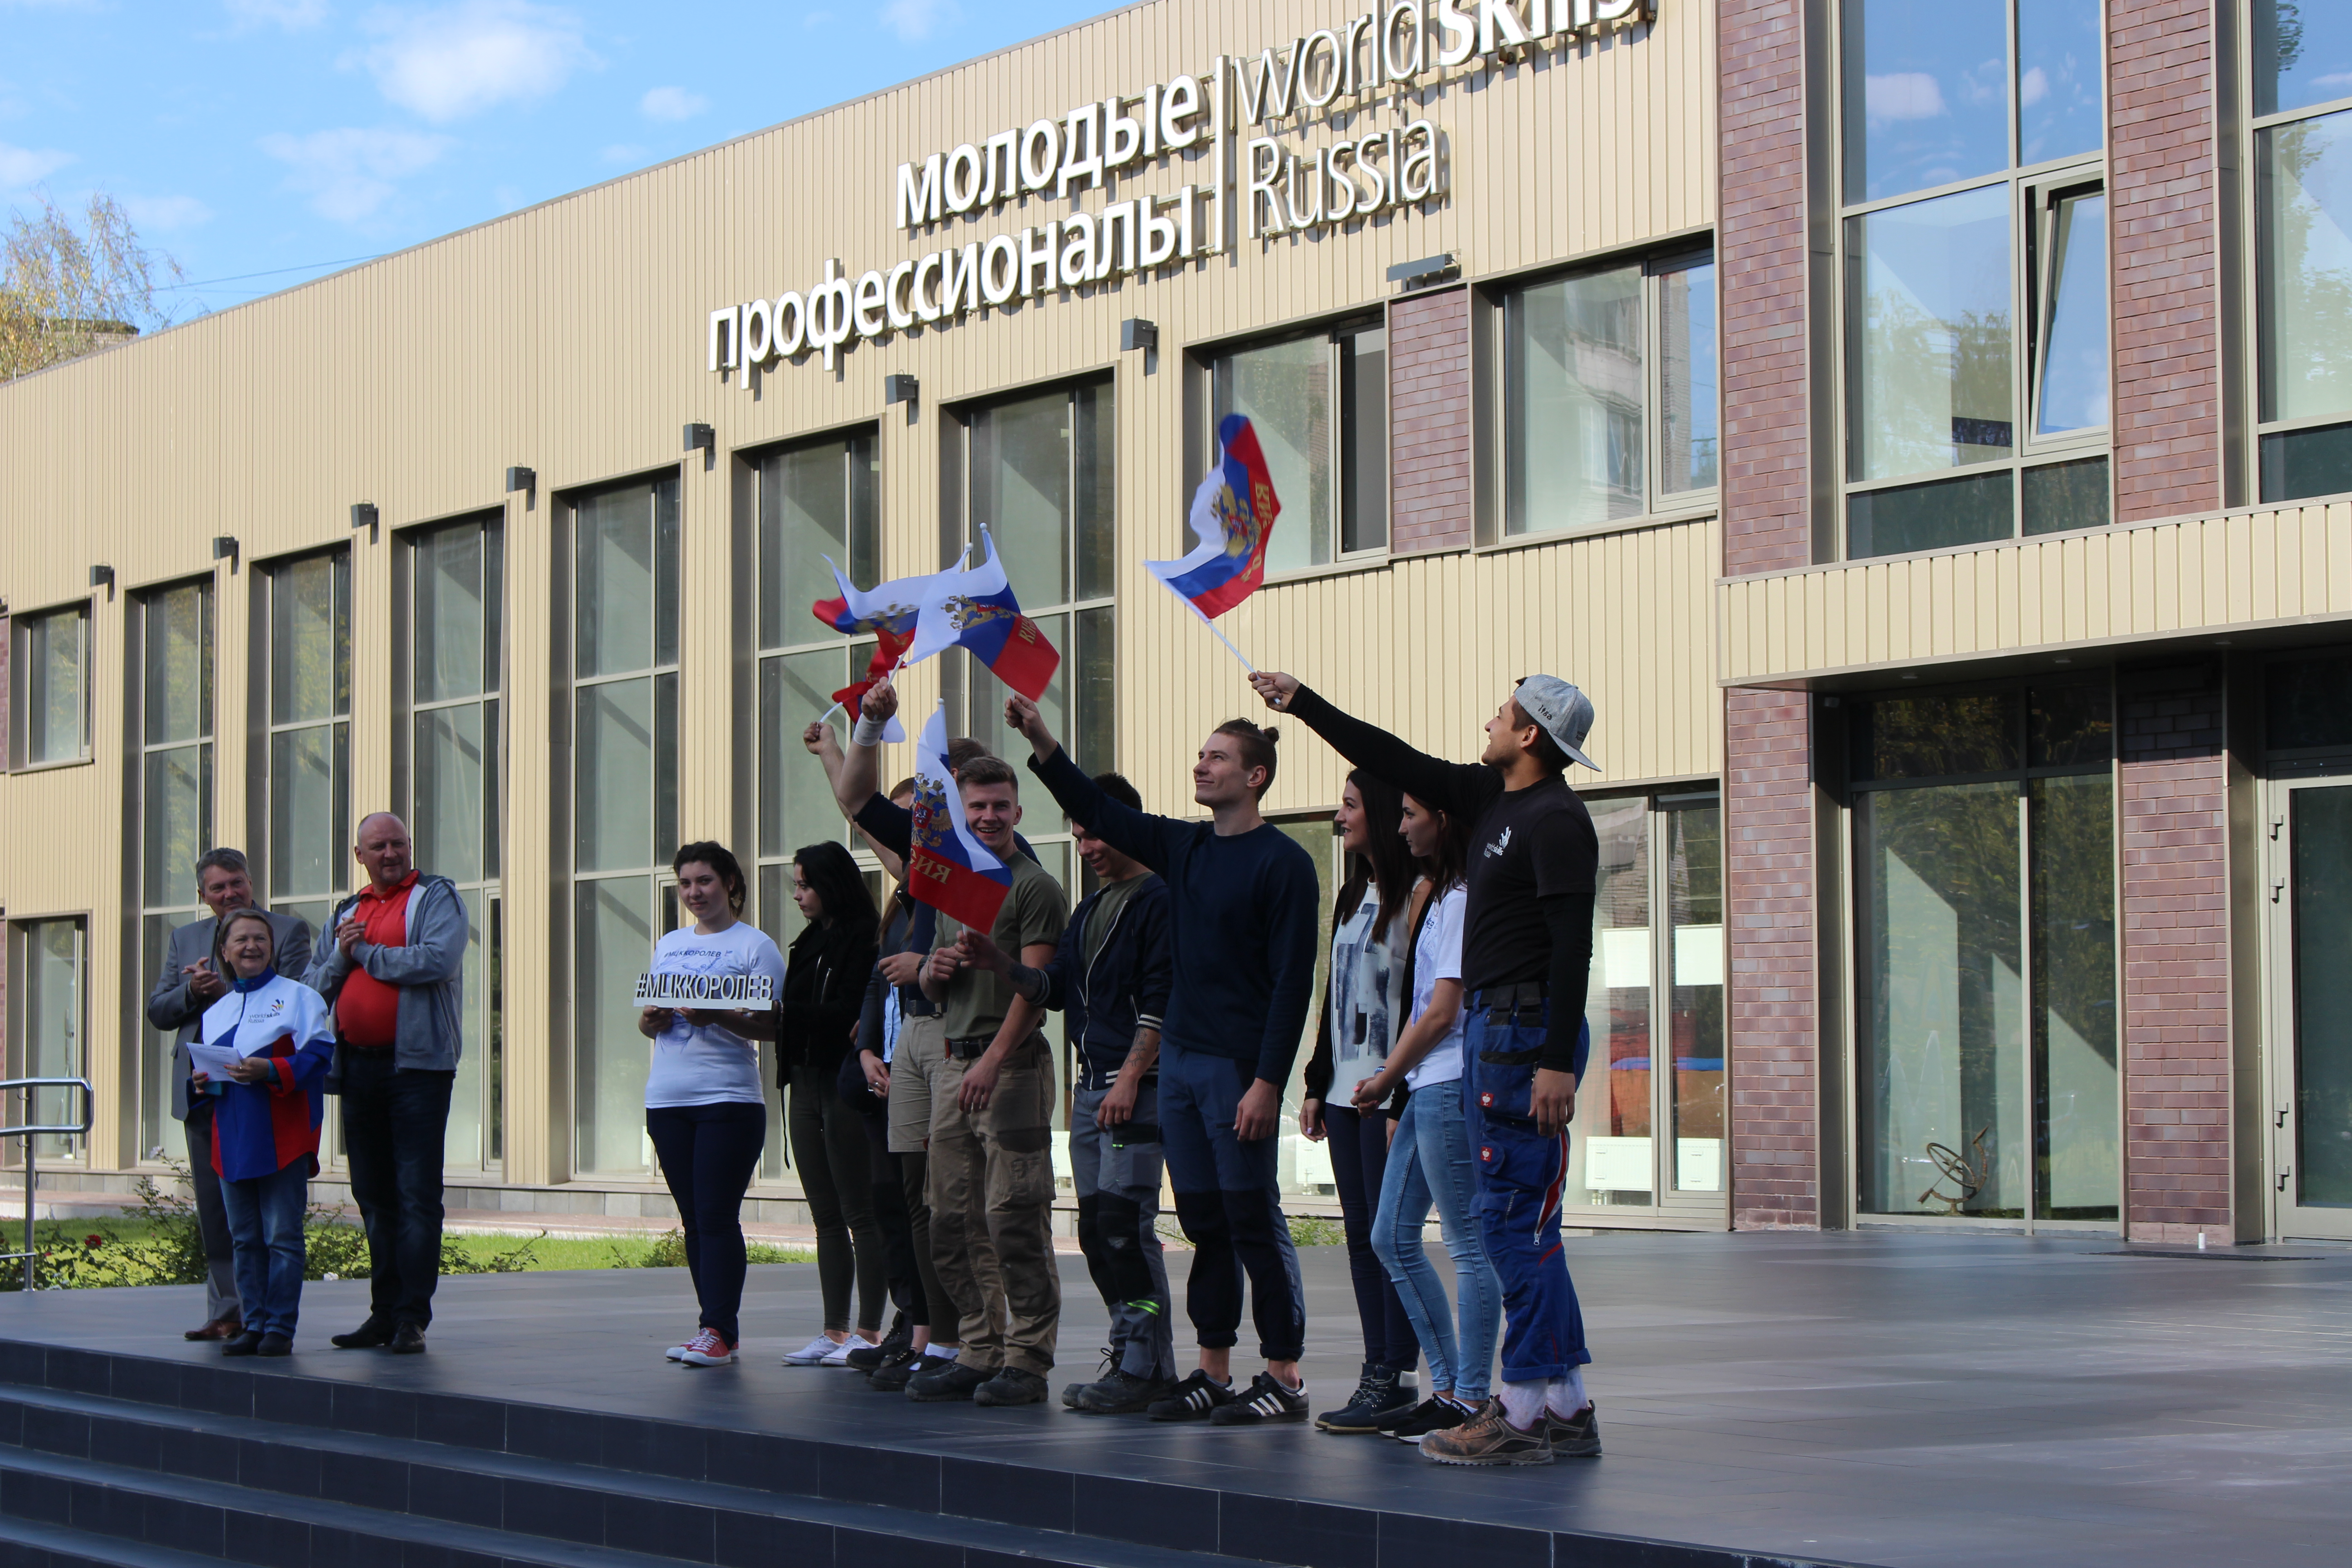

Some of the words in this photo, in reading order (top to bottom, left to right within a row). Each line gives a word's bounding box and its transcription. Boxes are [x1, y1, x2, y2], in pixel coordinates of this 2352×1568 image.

[1235, 0, 1637, 126] worldsk
[897, 74, 1202, 230] молодые
[1248, 96, 1440, 240] Russia
[709, 184, 1195, 390] профессионалы
[635, 973, 773, 1000] #МЦККОРОЛЕВ
[1451, 1401, 1460, 1410] FILA
